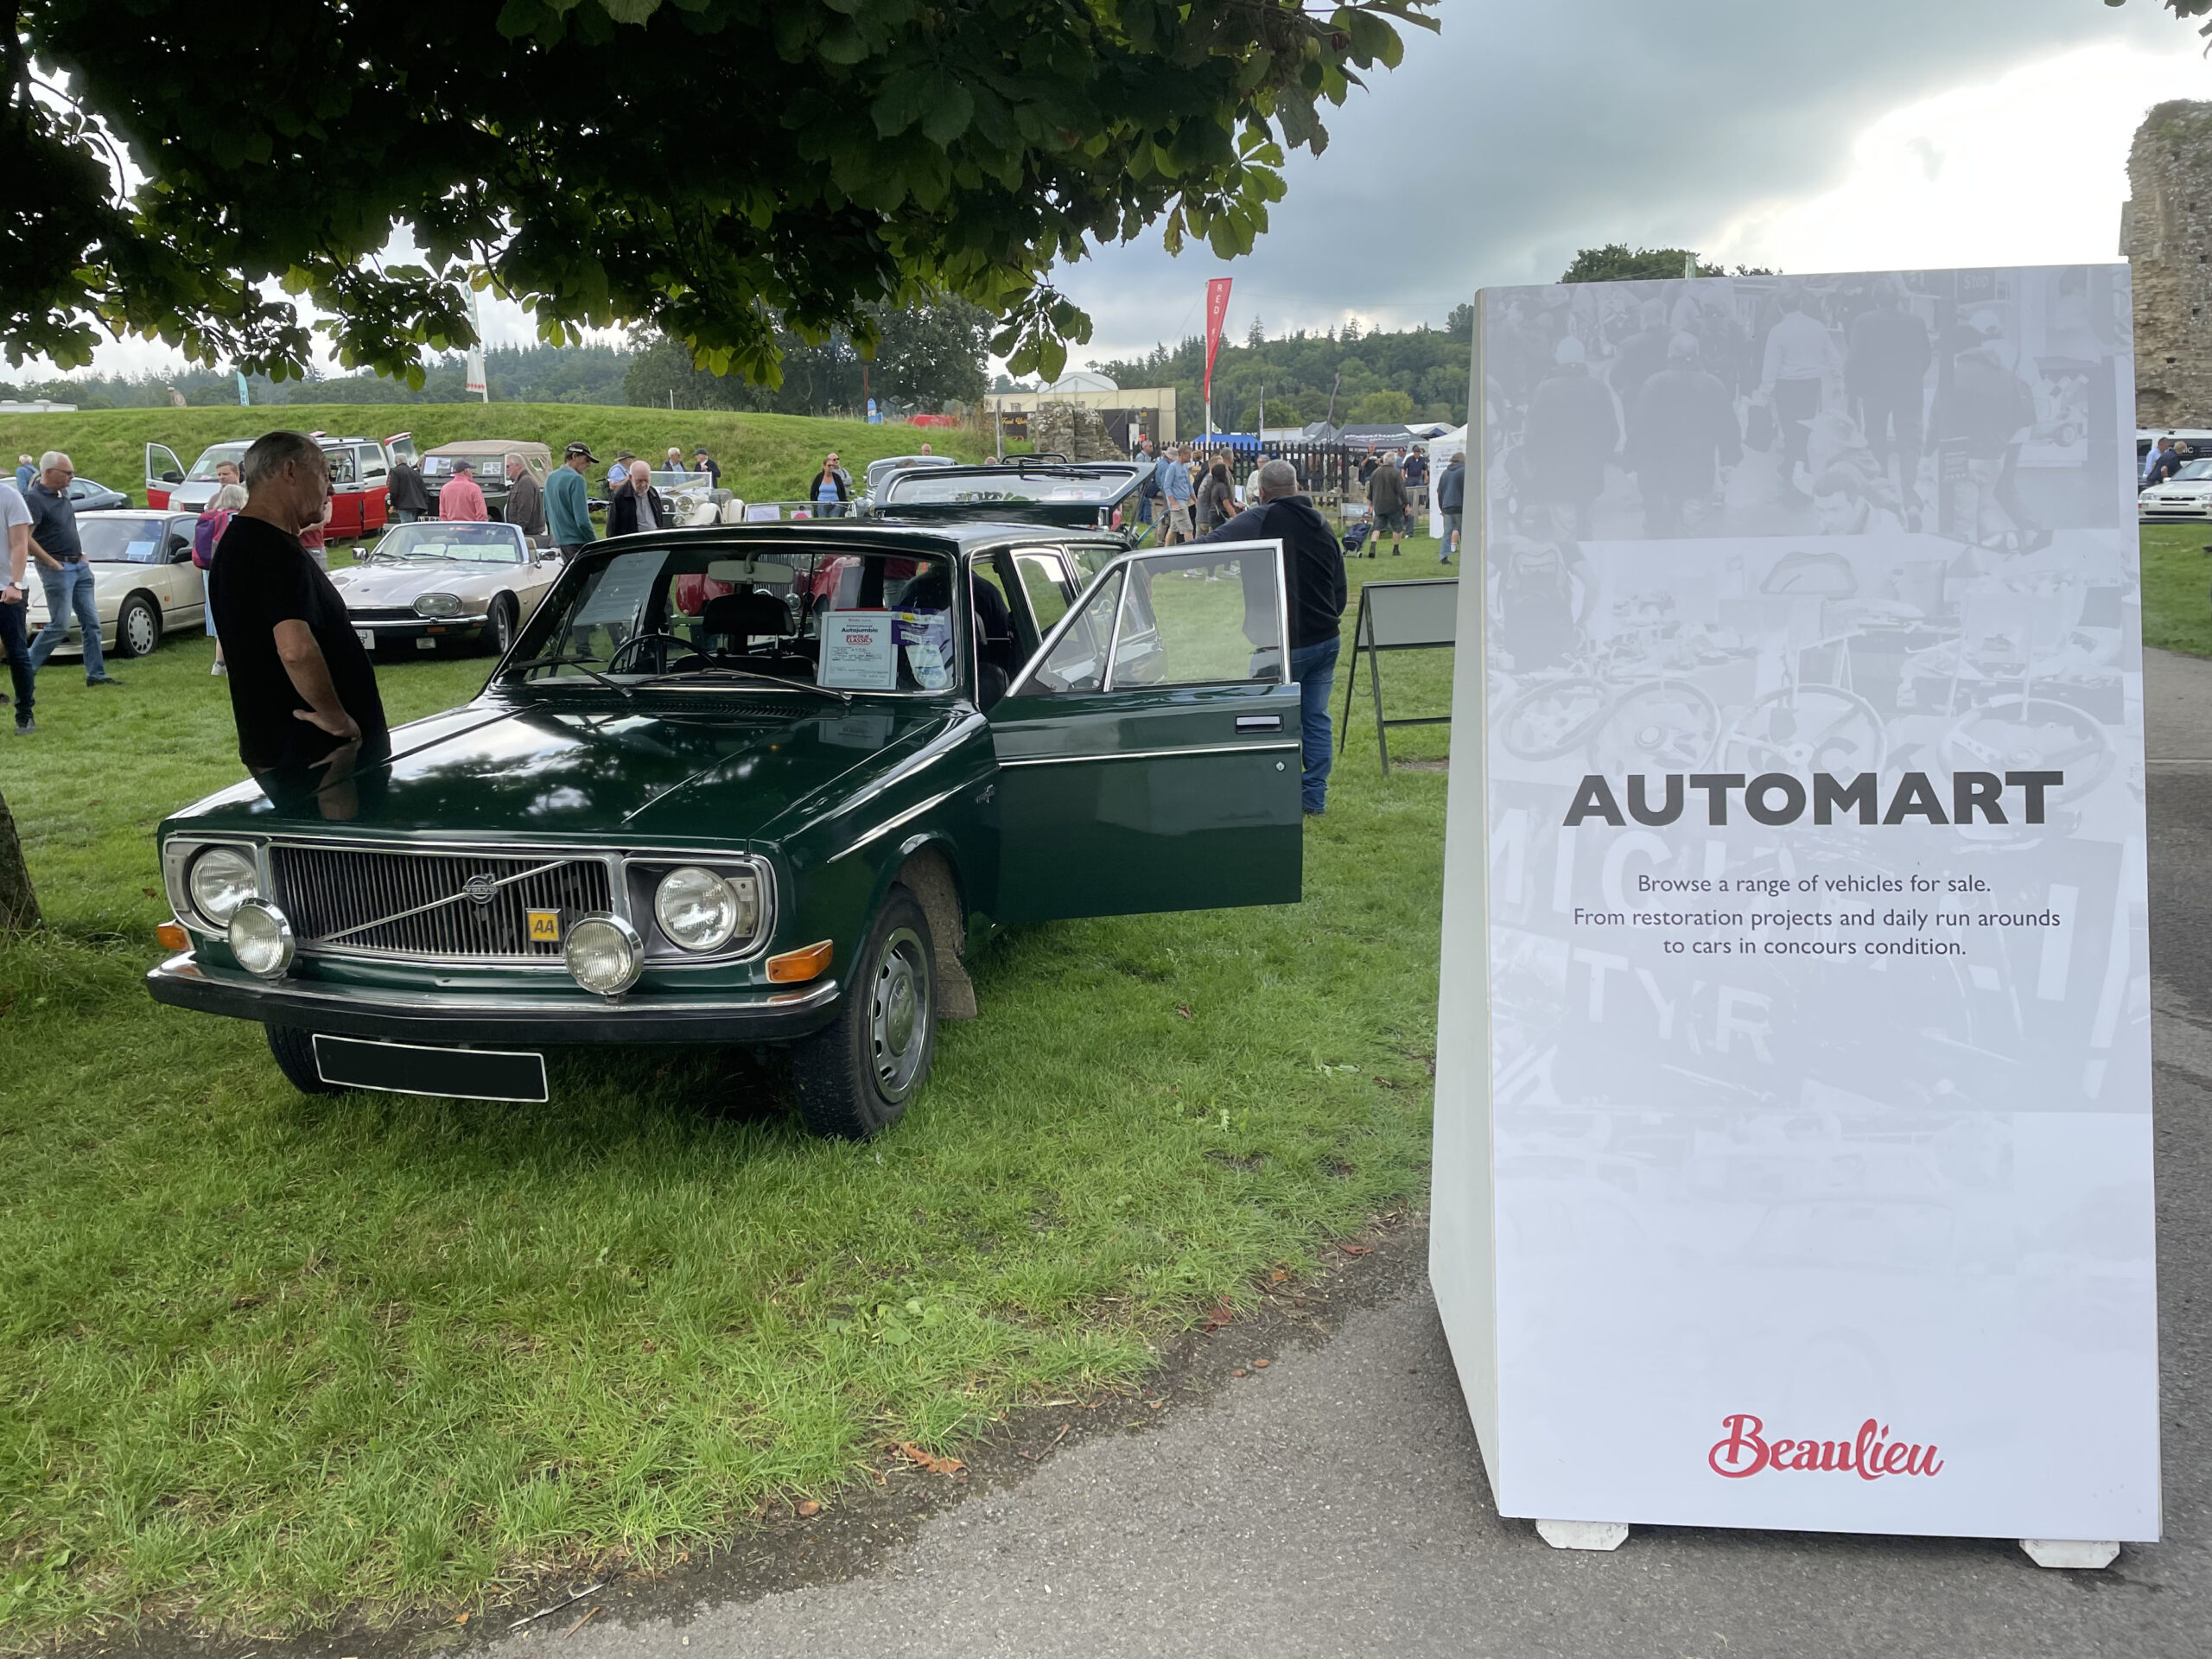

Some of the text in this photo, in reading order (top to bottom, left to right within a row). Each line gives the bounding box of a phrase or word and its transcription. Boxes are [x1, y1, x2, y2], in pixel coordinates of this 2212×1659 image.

[1212, 283, 1224, 315] RED
[1563, 771, 2063, 826] AUTOMART
[1638, 874, 1992, 897] Browse a range of vehicles for sale.
[534, 919, 556, 933] AA
[1573, 908, 2061, 931] From restoration projects and daily run arounds
[1663, 938, 1967, 955] to cars in concours condition.
[1708, 1414, 1943, 1480] Beaulieu
